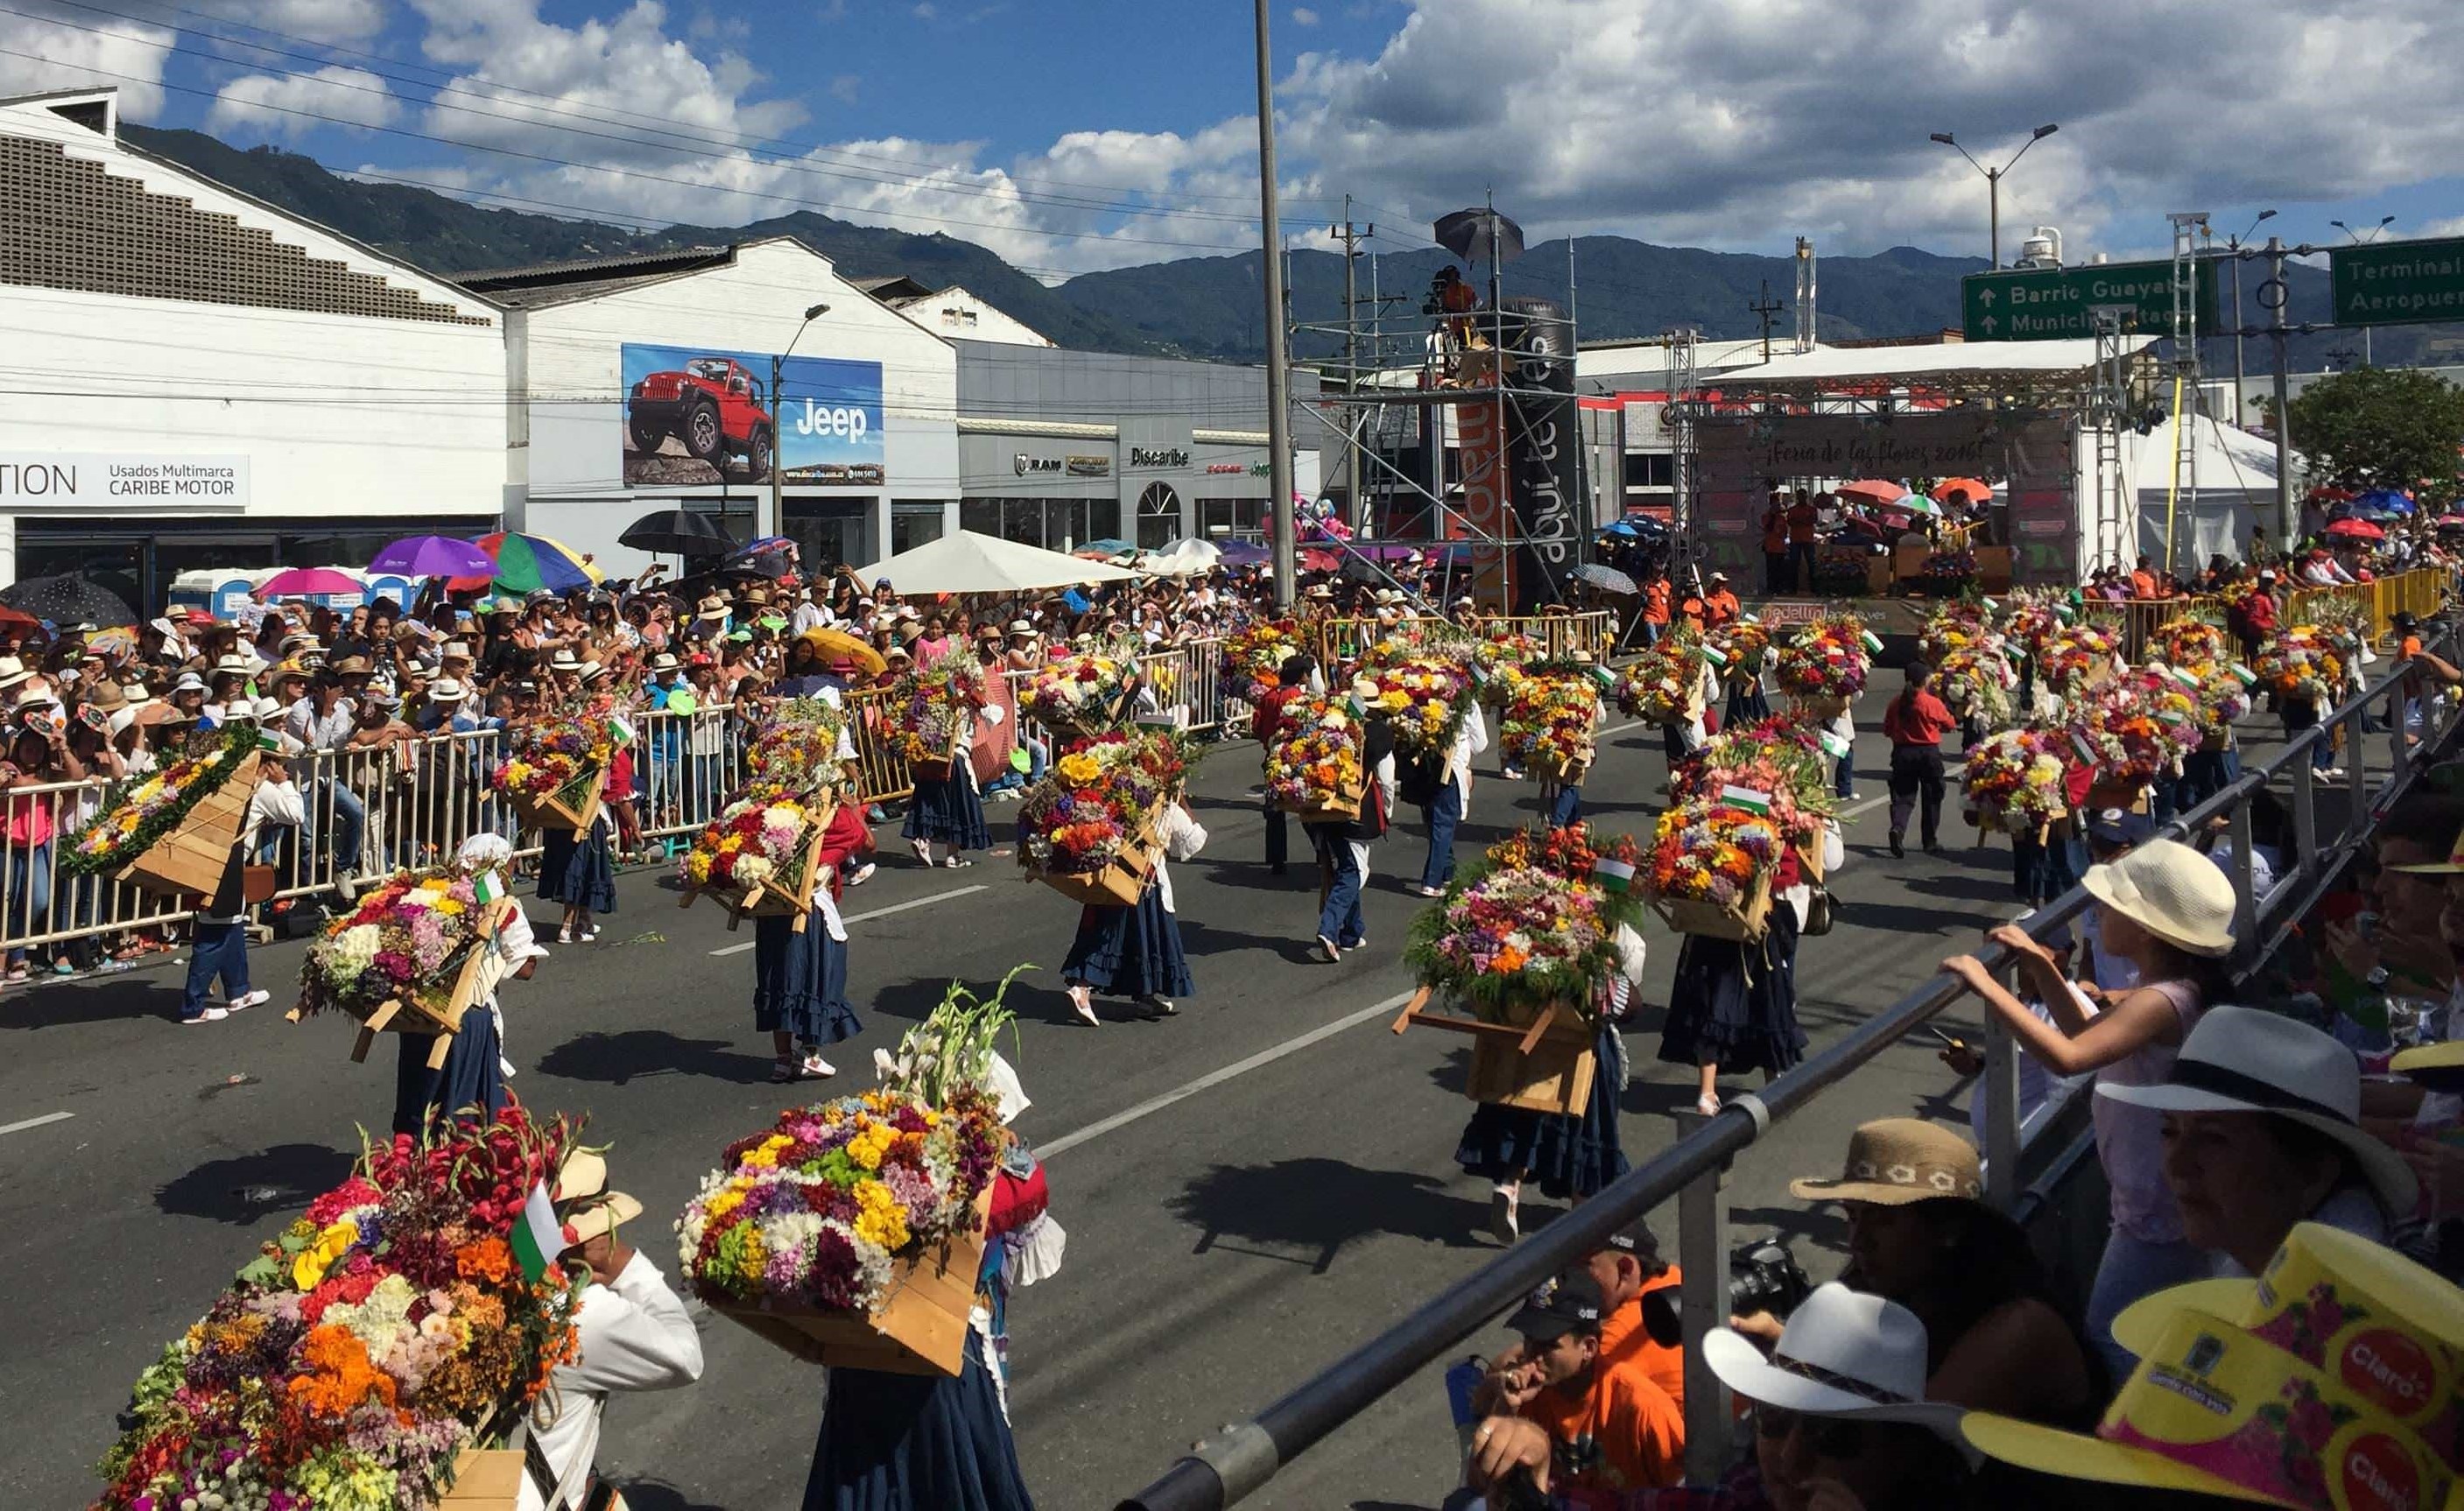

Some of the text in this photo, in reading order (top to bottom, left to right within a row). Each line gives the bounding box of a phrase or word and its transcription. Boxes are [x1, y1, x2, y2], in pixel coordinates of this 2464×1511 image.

[797, 398, 867, 443] Jeep
[1131, 447, 1189, 466] Discaribe
[1821, 439, 1841, 463] de
[109, 464, 235, 478] Usados Multimarca
[1030, 460, 1061, 472] RAM
[109, 480, 234, 495] CARIBE MOTOR
[2351, 1343, 2414, 1398] Claro
